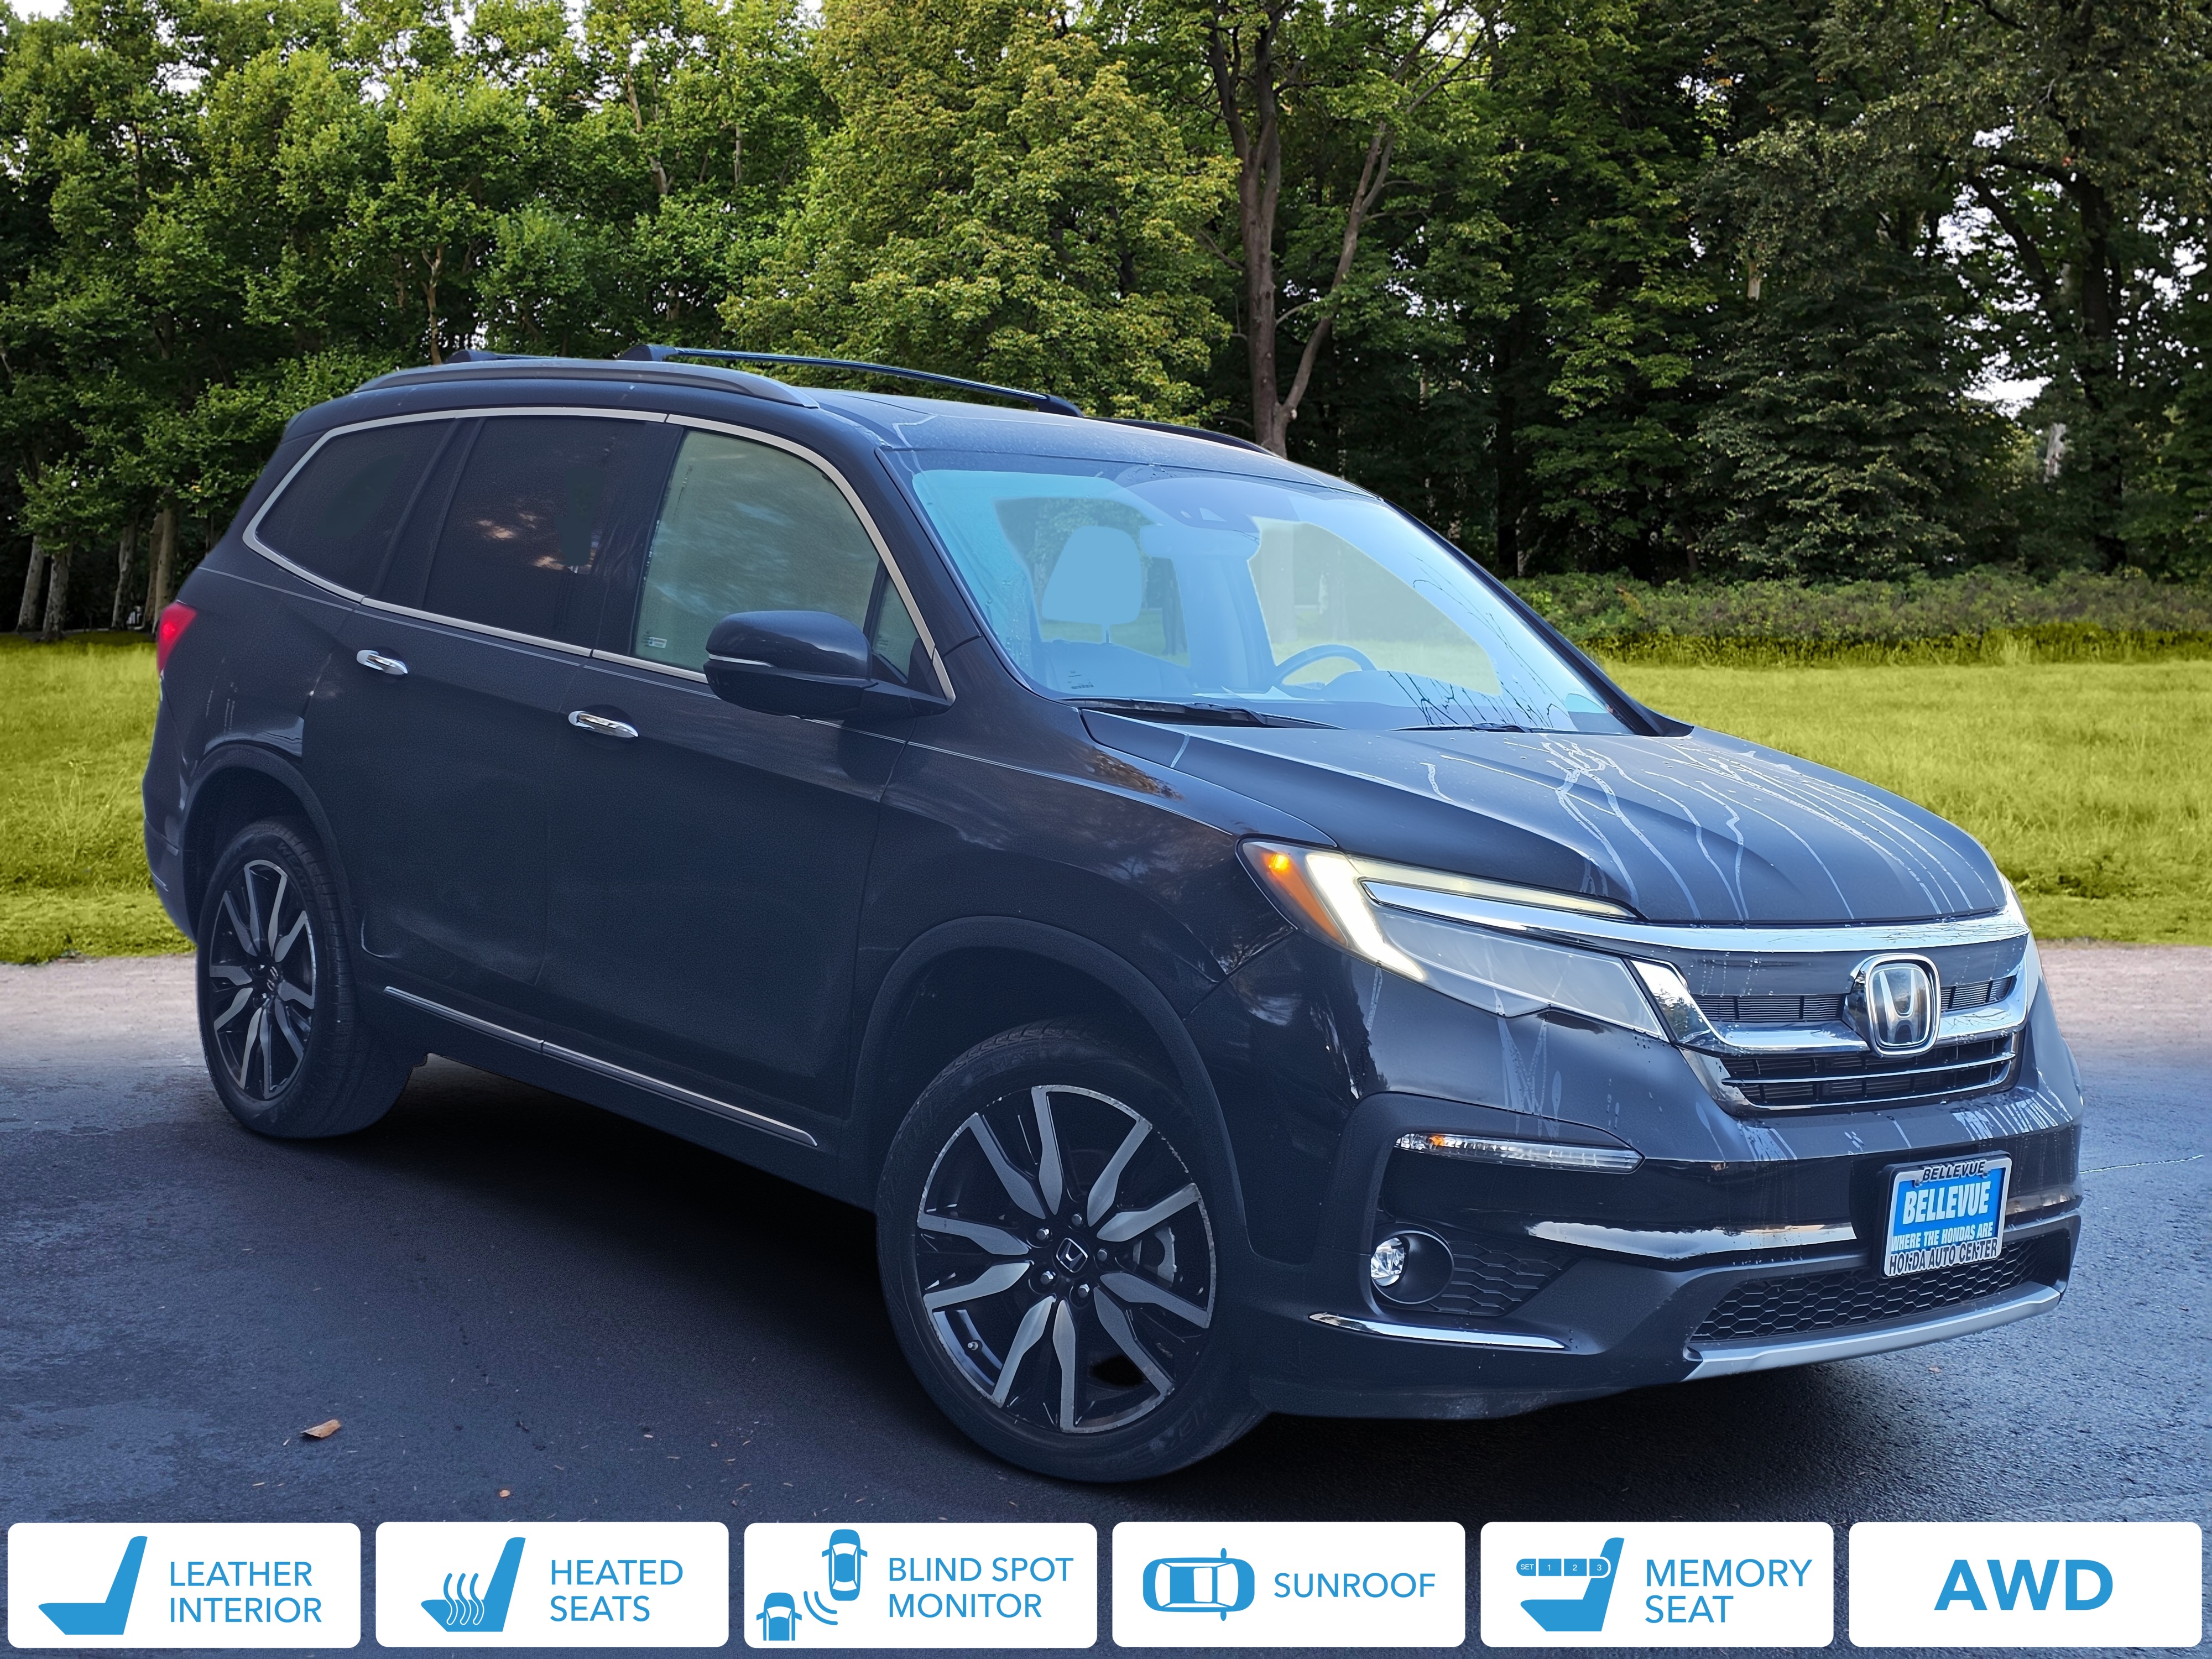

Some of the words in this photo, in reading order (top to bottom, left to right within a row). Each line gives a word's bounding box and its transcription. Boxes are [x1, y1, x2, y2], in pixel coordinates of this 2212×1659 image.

[1922, 1161, 1986, 1181] BELLEVUE
[1902, 1181, 1991, 1224] BELLEVUE
[1891, 1232, 1922, 1251] WHERE
[1923, 1229, 1939, 1246] THE
[1941, 1224, 1975, 1244] HONDAS
[1976, 1222, 1994, 1238] ARE
[1889, 1250, 1926, 1275] HONDA
[1928, 1244, 1956, 1268] AUTO
[1959, 1239, 1998, 1262] CENTER
